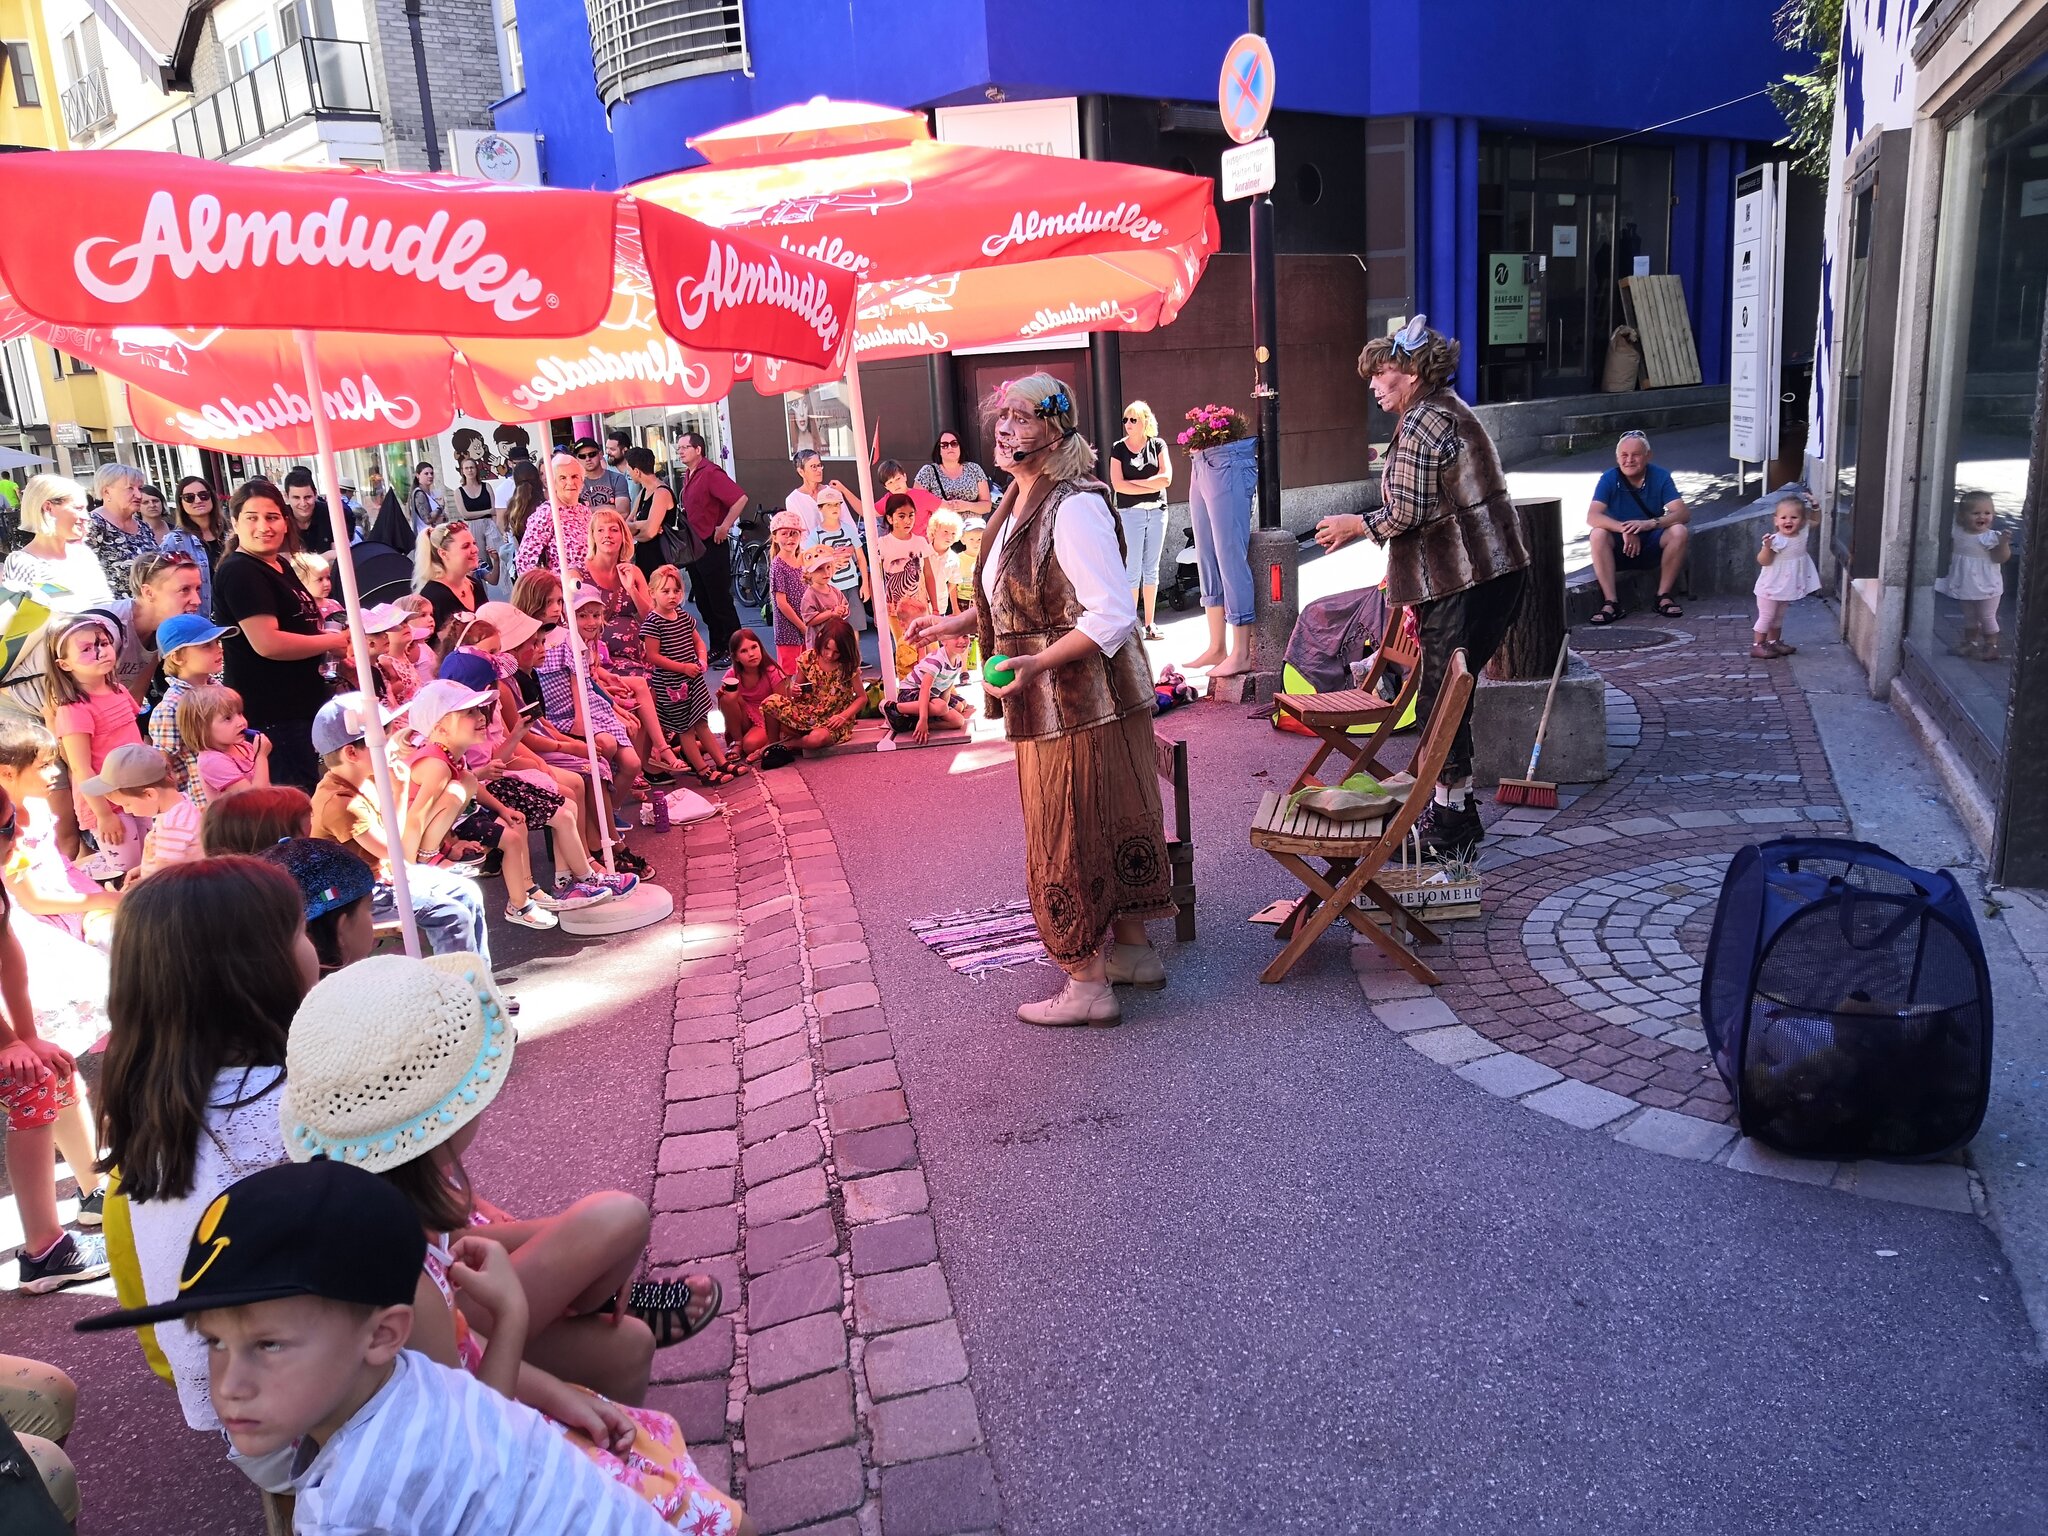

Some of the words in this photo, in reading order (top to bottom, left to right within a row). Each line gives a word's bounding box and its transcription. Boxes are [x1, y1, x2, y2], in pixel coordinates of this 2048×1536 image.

[74, 191, 542, 322] Almdudler
[982, 202, 1162, 257] Almdudler
[676, 240, 840, 352] Almdudler
